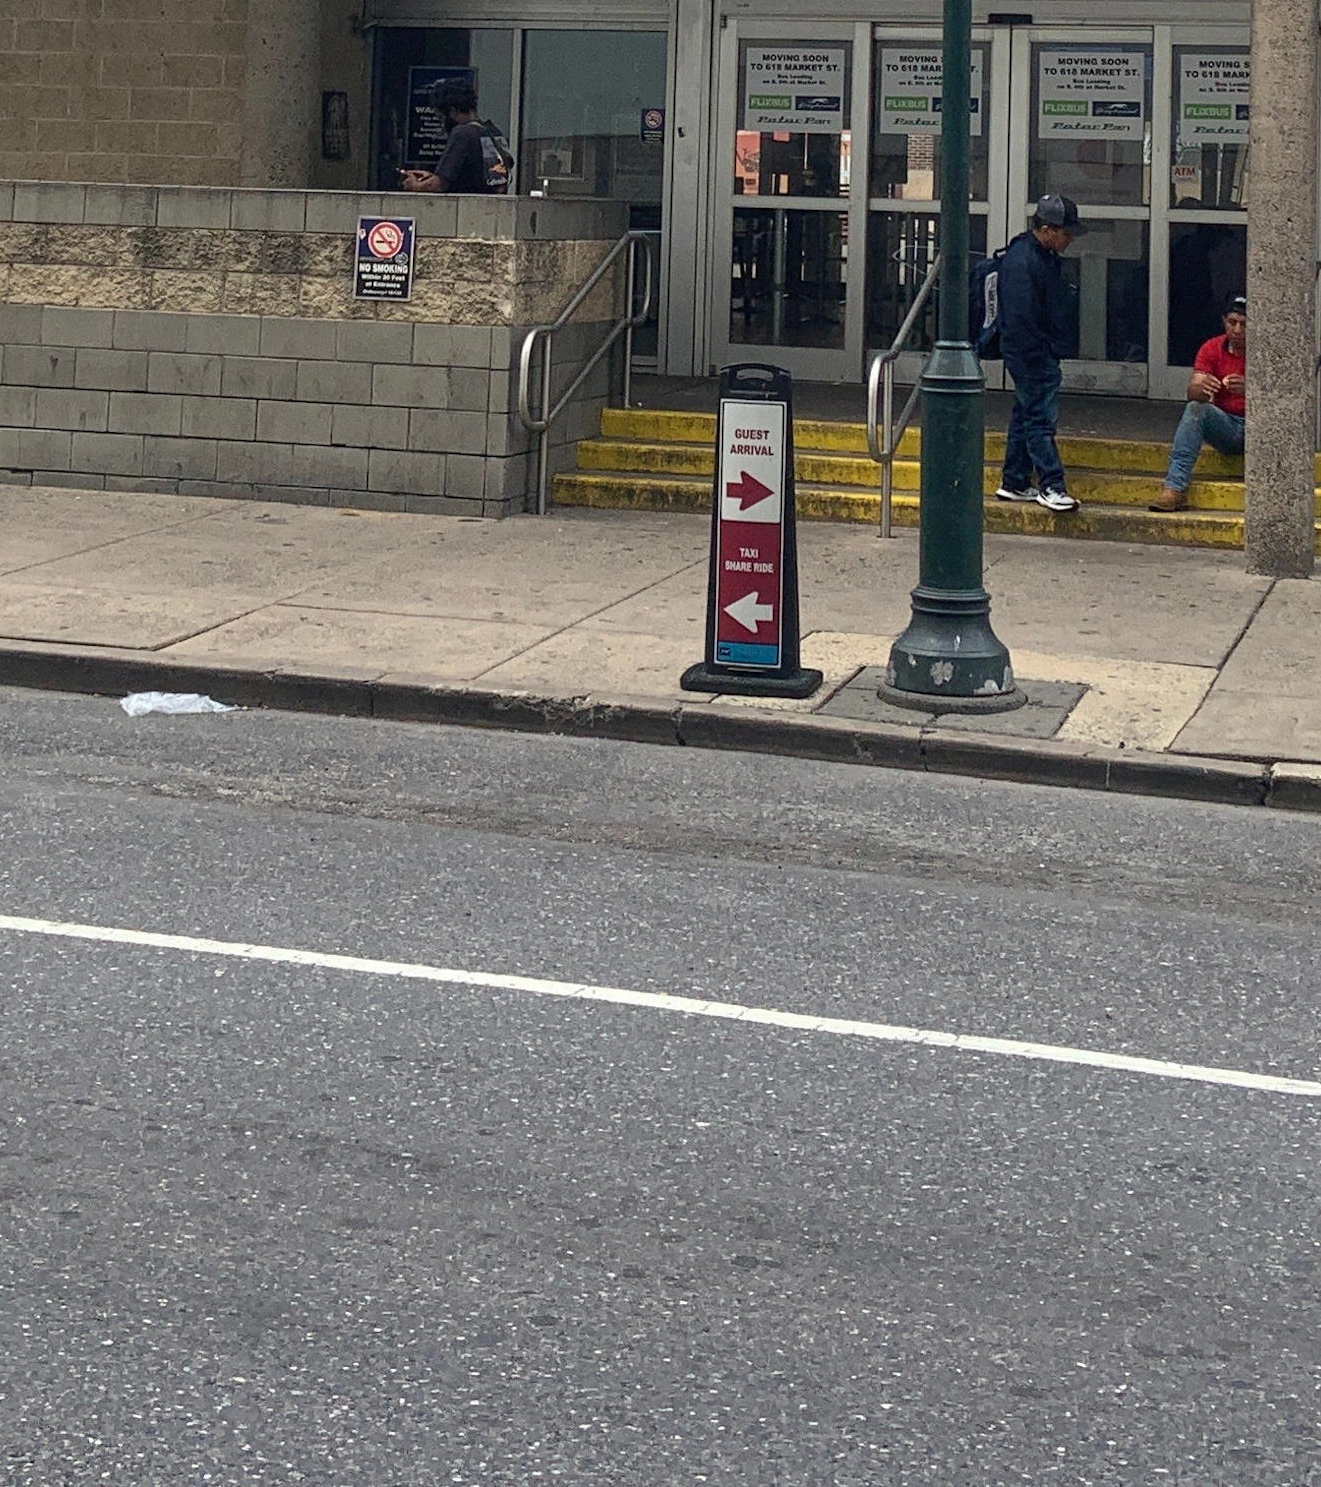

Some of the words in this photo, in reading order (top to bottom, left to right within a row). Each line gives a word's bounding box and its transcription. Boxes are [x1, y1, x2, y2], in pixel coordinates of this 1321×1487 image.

[762, 54, 800, 62] MOVING
[1101, 58, 1129, 66] SOON
[784, 64, 823, 72] MARKET
[359, 263, 371, 272] NO
[372, 264, 408, 273] SMOKING
[735, 428, 770, 440] GUEST
[730, 444, 774, 456] ARRIVAL
[739, 547, 758, 558] TAXI
[725, 560, 752, 572] SHARE
[753, 563, 774, 574] RIDE
